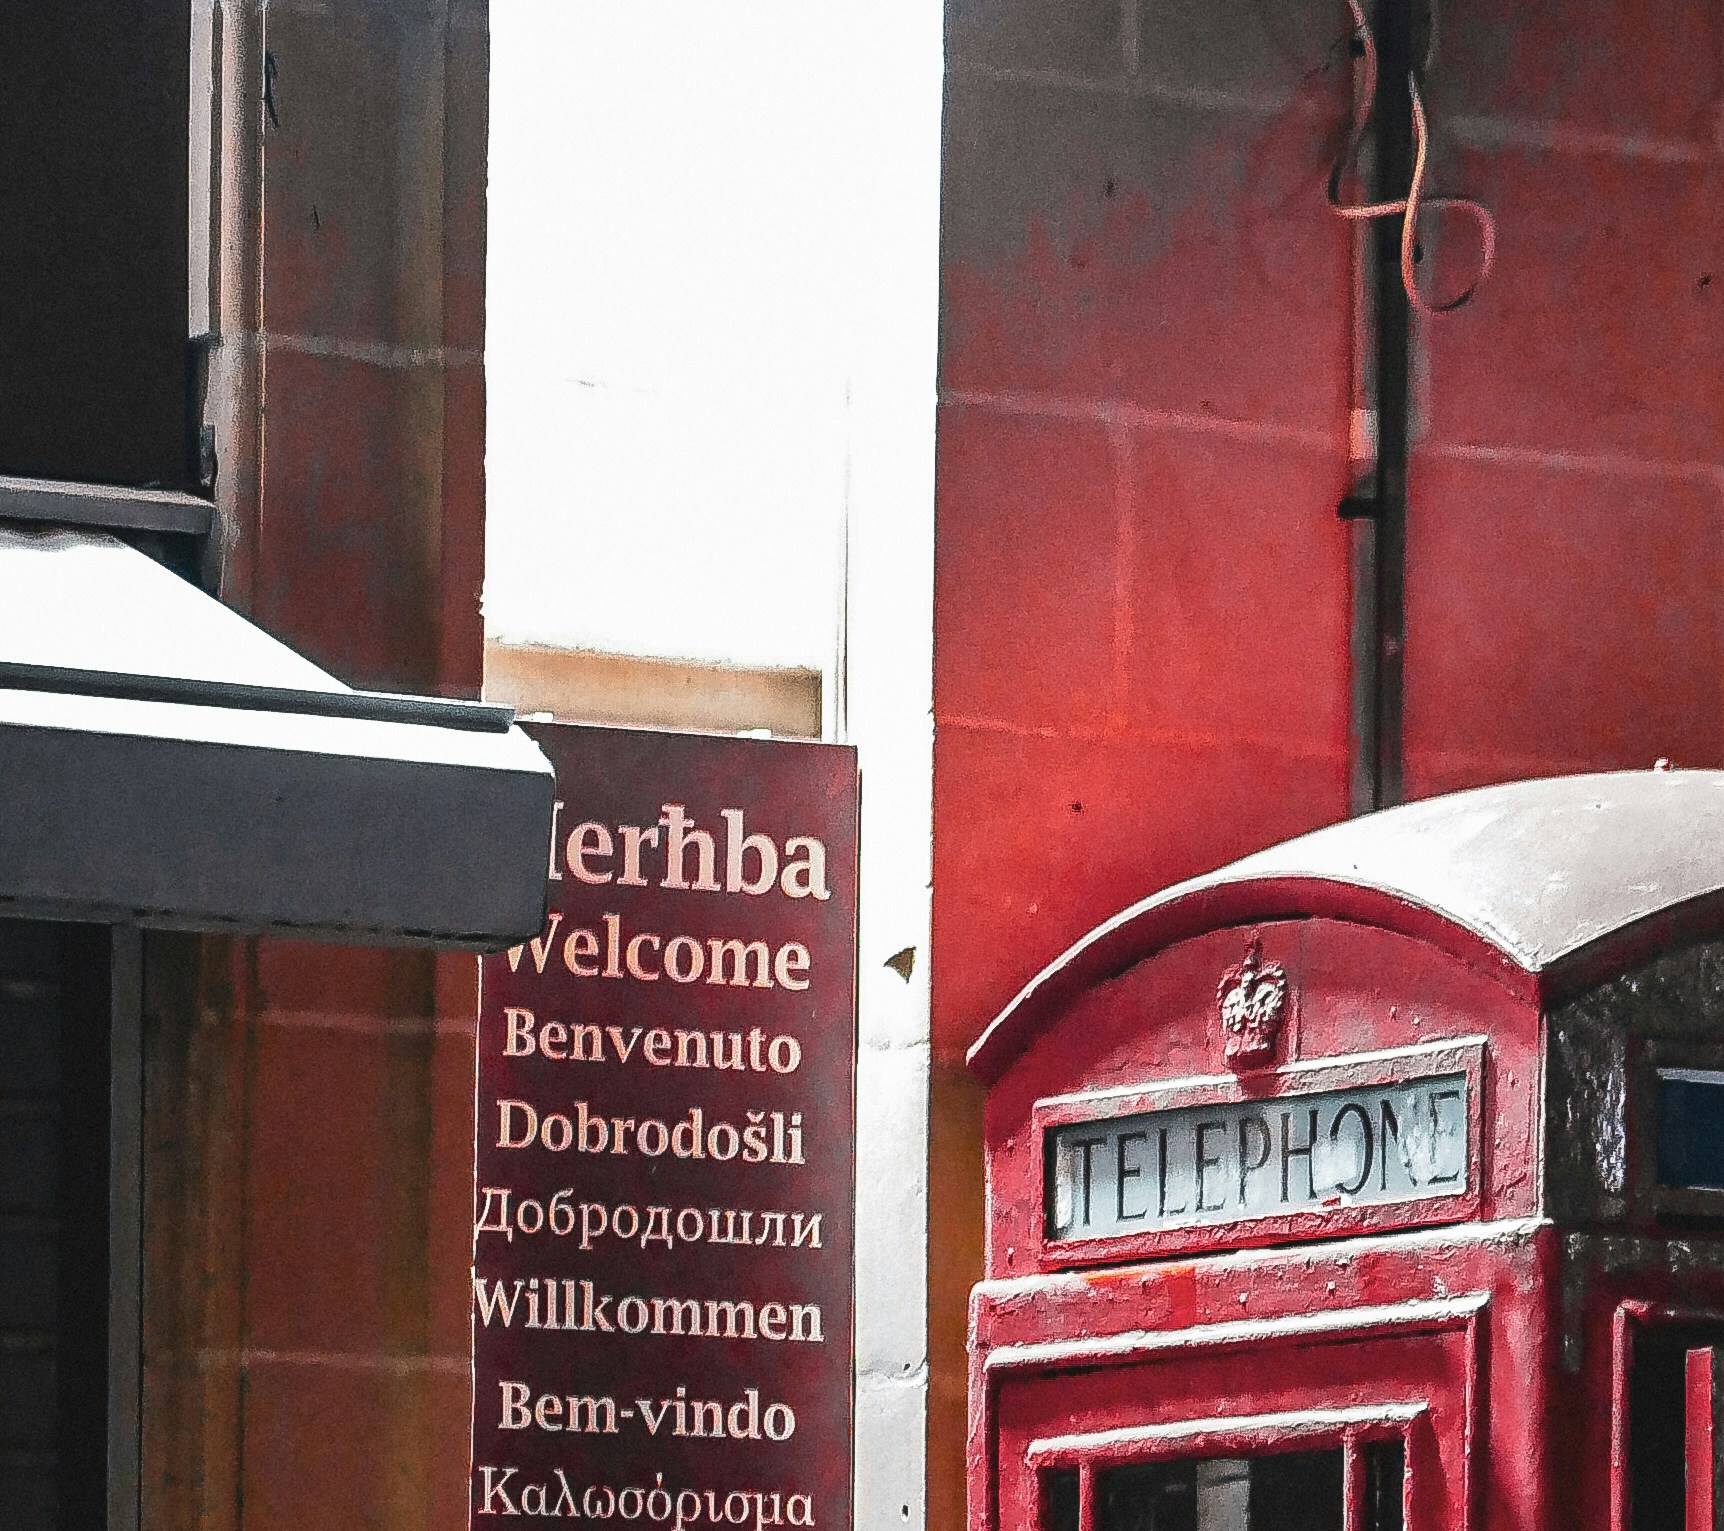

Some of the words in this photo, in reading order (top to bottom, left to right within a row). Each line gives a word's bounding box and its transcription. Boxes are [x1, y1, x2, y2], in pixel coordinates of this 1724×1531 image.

[549, 801, 831, 900] erħba
[502, 1007, 802, 1075] Benvenuto
[496, 1099, 806, 1165] Dobrodošli
[1066, 1090, 1460, 1227] TELEPHONE
[475, 1187, 823, 1250] Добродошли
[475, 1277, 825, 1342] Willkommen
[498, 1381, 796, 1441] Bem-vindo
